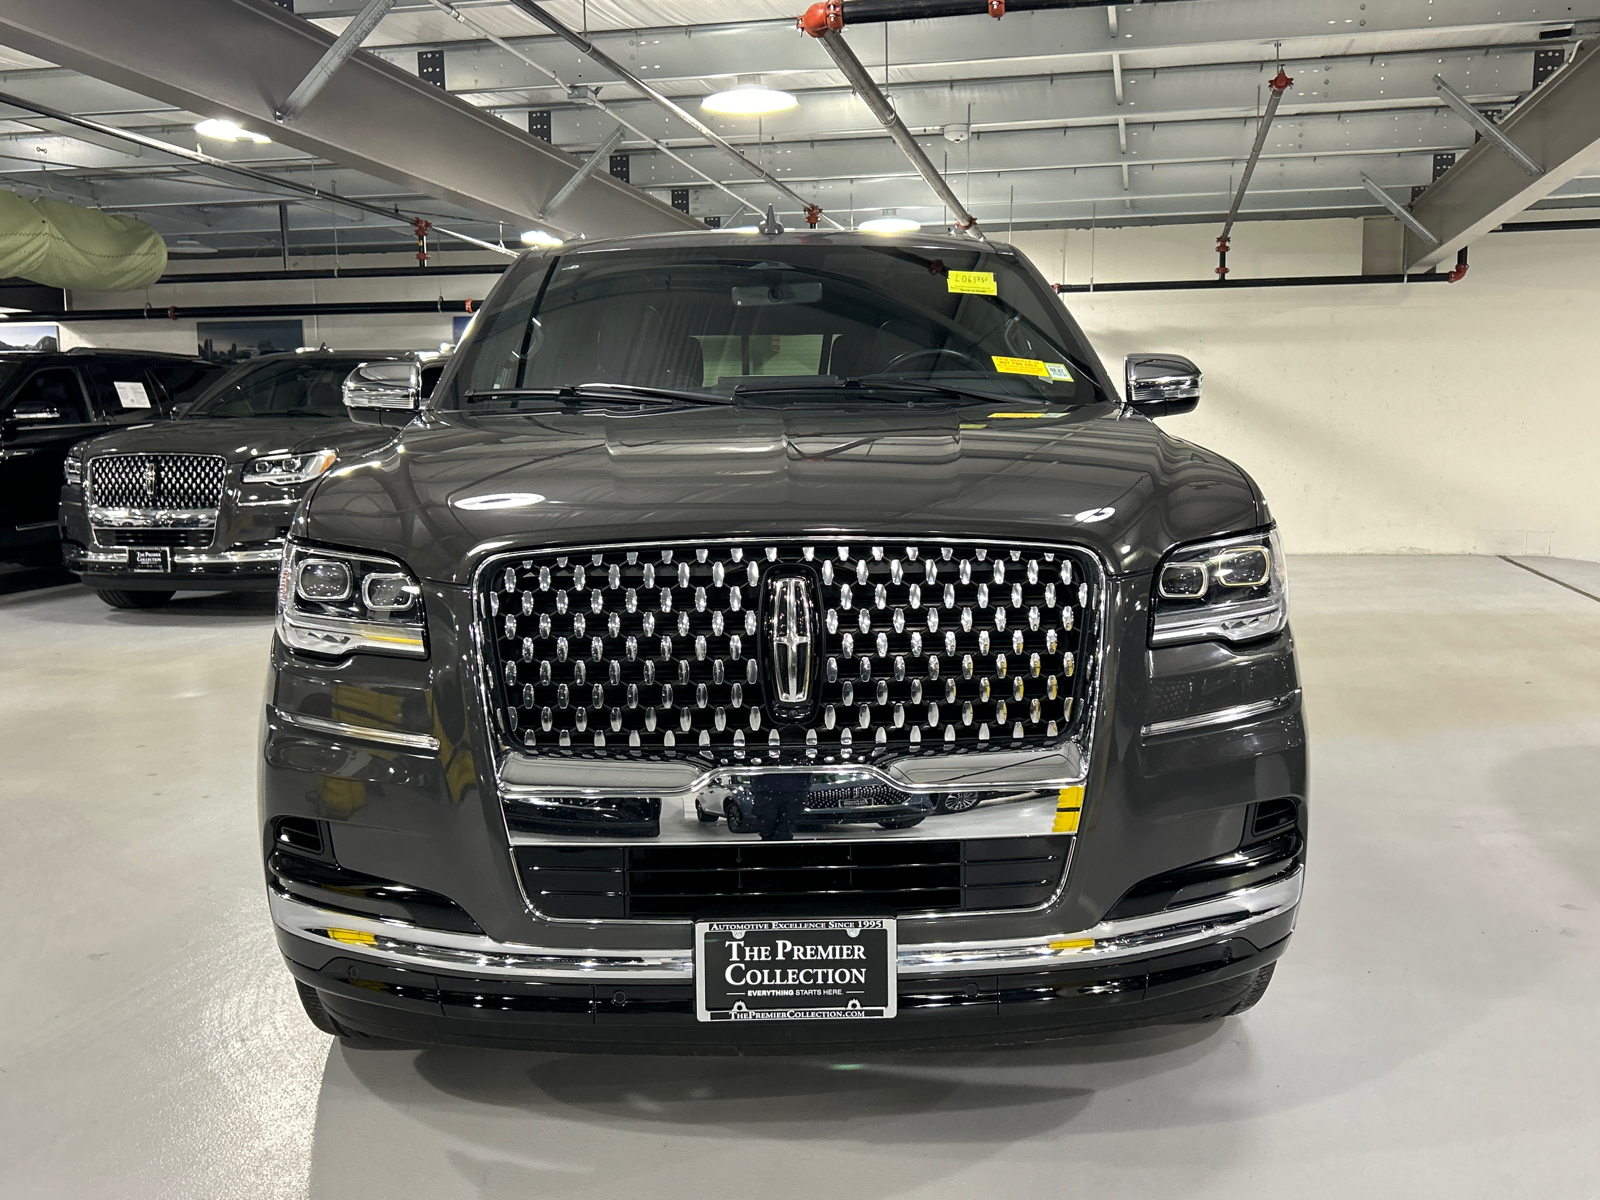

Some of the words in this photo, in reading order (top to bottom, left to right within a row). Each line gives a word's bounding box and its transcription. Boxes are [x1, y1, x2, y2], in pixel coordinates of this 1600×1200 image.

[711, 923, 769, 931] AUTOMOTIVE
[857, 920, 882, 928] 1995
[725, 940, 772, 961] THE
[775, 939, 867, 960] PREMIER
[725, 963, 867, 986] COLLECTION
[747, 989, 794, 997] EVERYTHING
